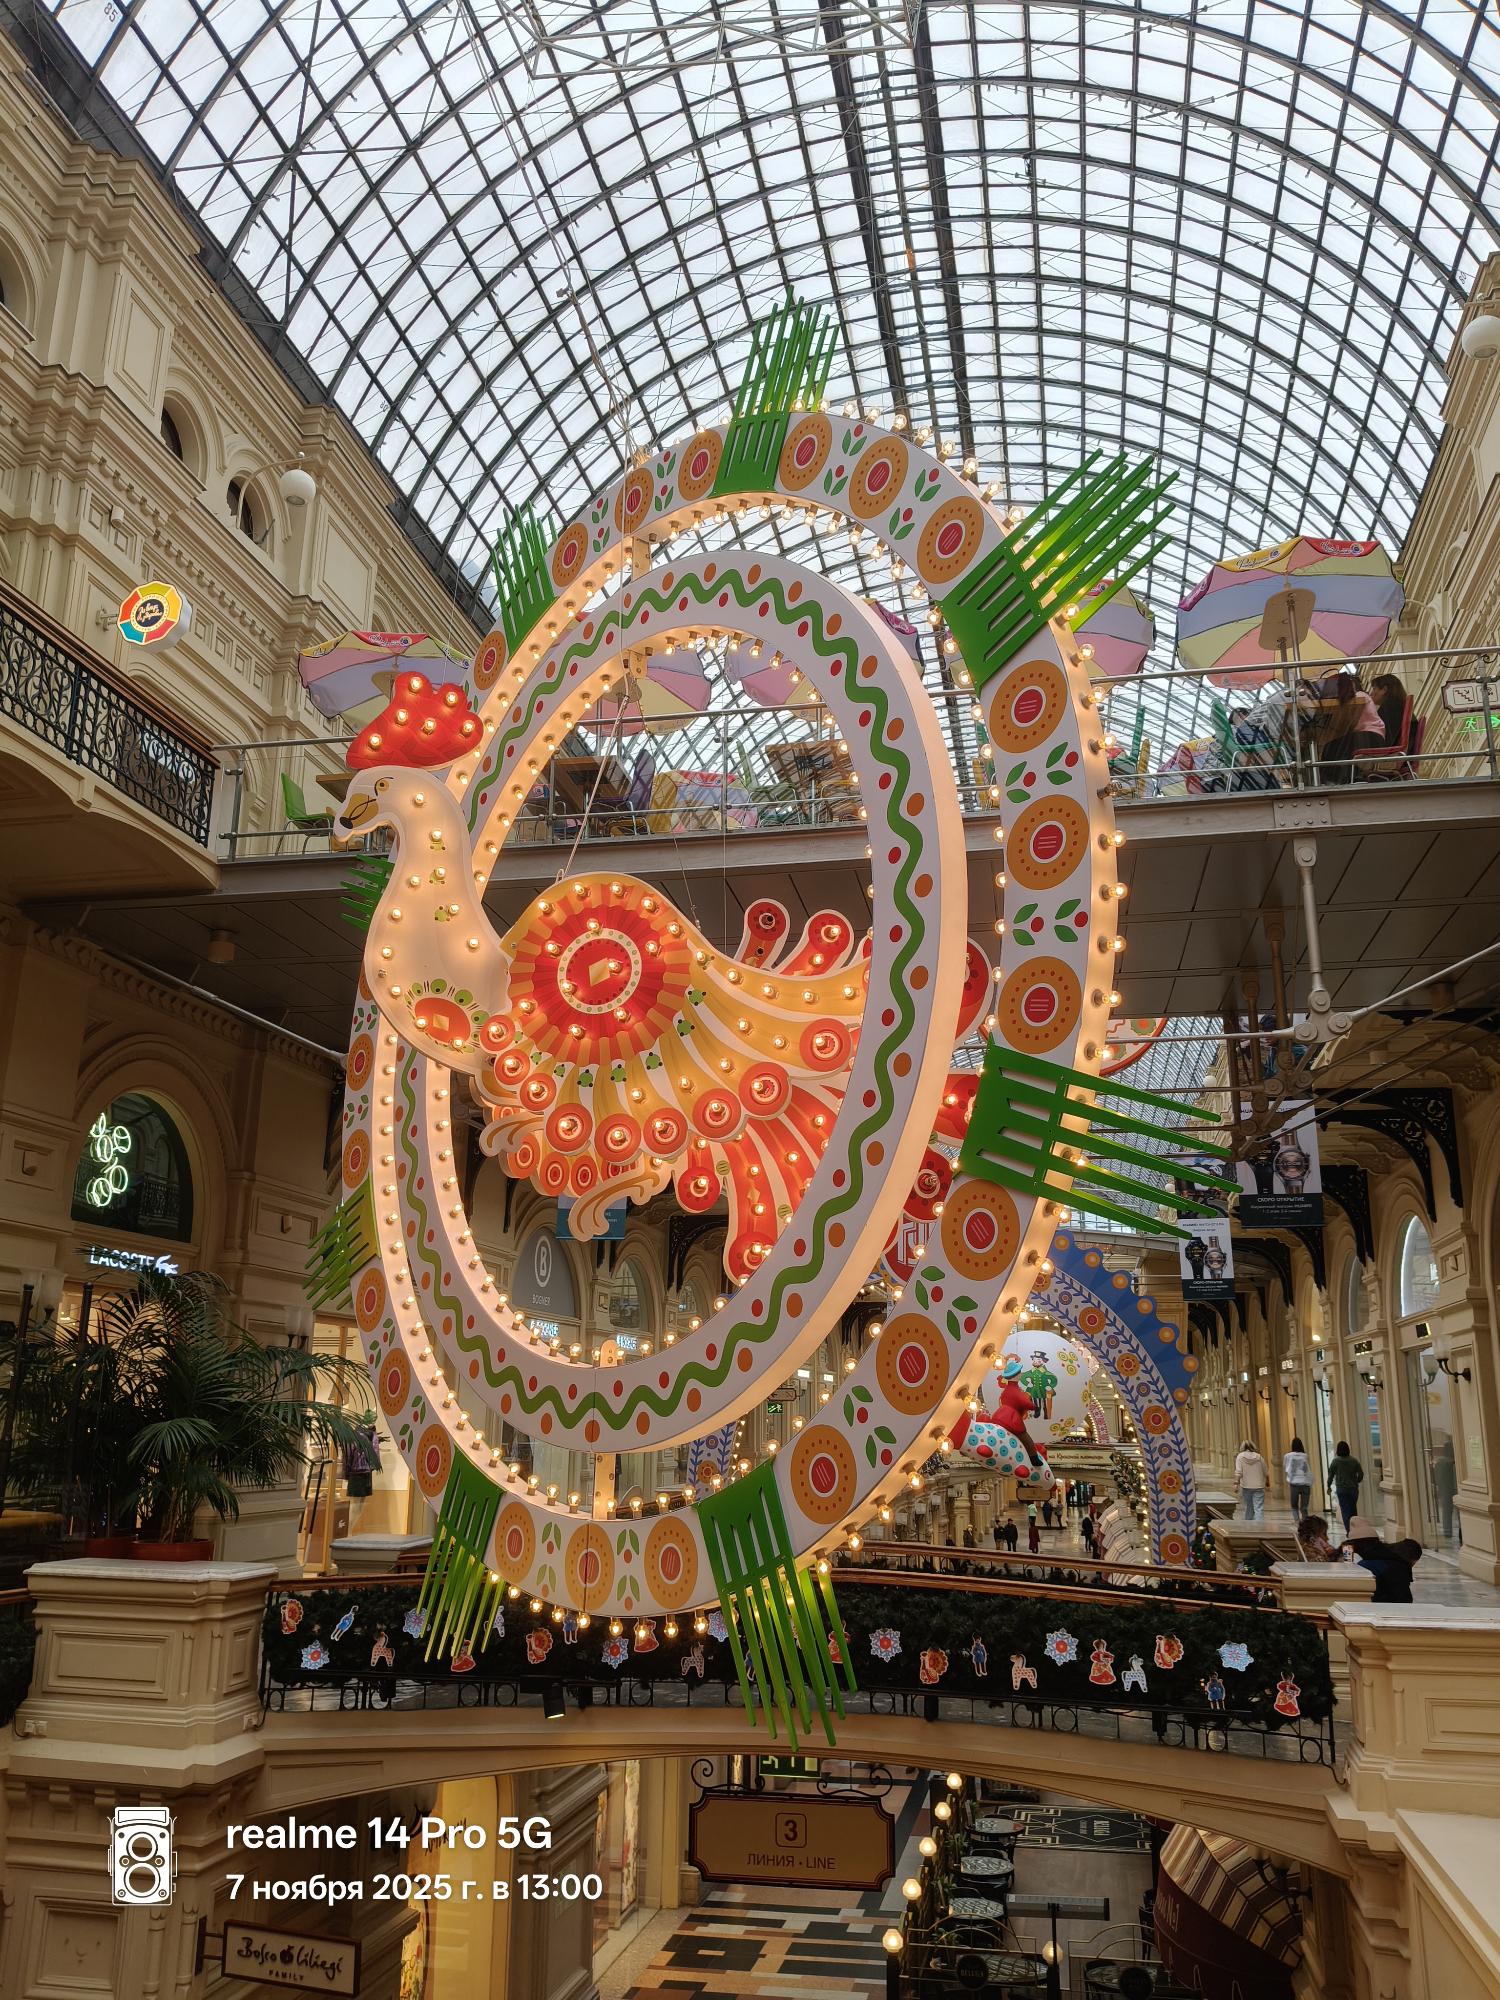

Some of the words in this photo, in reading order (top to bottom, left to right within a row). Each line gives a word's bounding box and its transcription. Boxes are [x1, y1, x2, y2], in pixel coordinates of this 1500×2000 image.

[89, 1246, 155, 1273] LACOSTE
[783, 1819, 799, 1842] 3
[746, 1853, 795, 1867] ЛИНИЯ
[806, 1857, 836, 1870] LINE
[236, 1936, 277, 1966] Bosco
[268, 1969, 304, 1982] FAMILY
